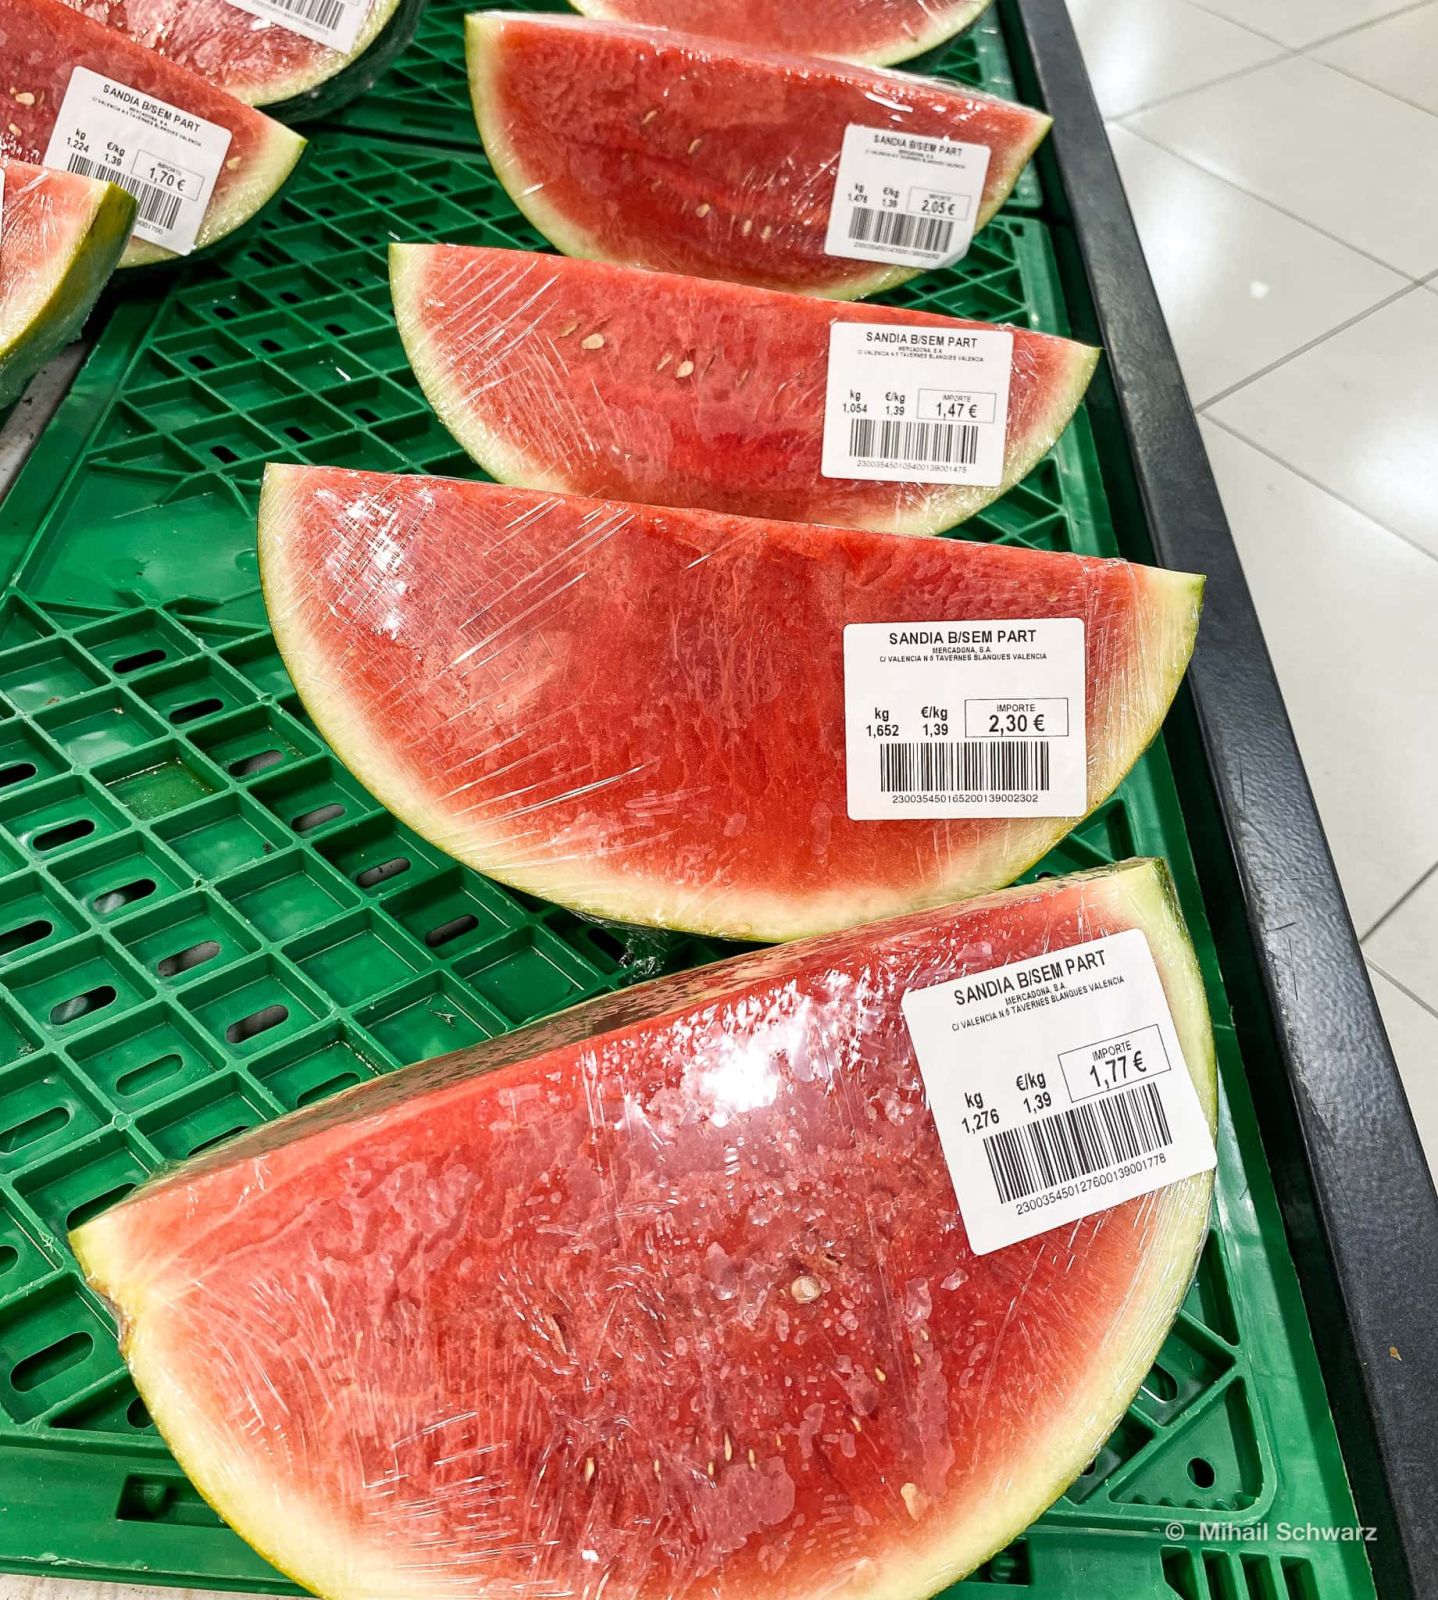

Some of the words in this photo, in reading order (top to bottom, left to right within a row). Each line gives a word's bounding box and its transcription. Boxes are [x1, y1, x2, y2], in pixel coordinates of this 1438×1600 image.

[104, 84, 139, 107] SANDIA
[142, 102, 171, 120] B/SEM
[174, 115, 200, 132] PART
[76, 128, 86, 140] kg
[107, 142, 125, 157] €/kg
[874, 135, 906, 146] SANDIA
[940, 146, 962, 156] PART
[150, 168, 174, 186] 1,70
[178, 180, 186, 191] €
[922, 200, 945, 214] 2,05
[948, 204, 956, 215] €
[866, 332, 907, 344] SANDIA
[911, 335, 944, 346] B/SEM
[948, 337, 977, 348] PART
[850, 390, 861, 401] kg
[885, 392, 905, 404] €/kg
[843, 403, 867, 414] 1,054
[886, 406, 905, 416] 1,39
[936, 402, 964, 421] 1,47
[969, 405, 977, 418] €
[889, 632, 944, 645] SANDIA
[948, 631, 992, 643] B/SEM
[998, 629, 1036, 643] PART
[875, 708, 889, 722] kg
[921, 706, 948, 721] €/kg
[997, 704, 1035, 712] IMPORTE
[866, 724, 899, 738] 1,652
[923, 724, 948, 738] 1,39
[989, 715, 1027, 736] 2,30
[1033, 714, 1045, 732] €
[892, 794, 1038, 803] 230035450165200139002302
[954, 977, 1014, 1005] SANDIA
[1017, 962, 1063, 989] B/SEM
[1066, 950, 1106, 975] PART
[961, 1012, 998, 1029] VALENCIA
[1011, 996, 1050, 1015] TAVERNES
[1051, 986, 1088, 1002] BLANQUES
[1089, 976, 1124, 992] VALENCIA
[1092, 1041, 1131, 1061] IMPORTE
[1090, 1056, 1127, 1088] 1,77
[1133, 1051, 1146, 1072] €
[1016, 1072, 1046, 1091] €/kg
[964, 1092, 984, 1109] kg
[1023, 1091, 1052, 1114] 1,39
[962, 1109, 999, 1134] 1,276
[1016, 1153, 1166, 1215] 230035450127600139001778
